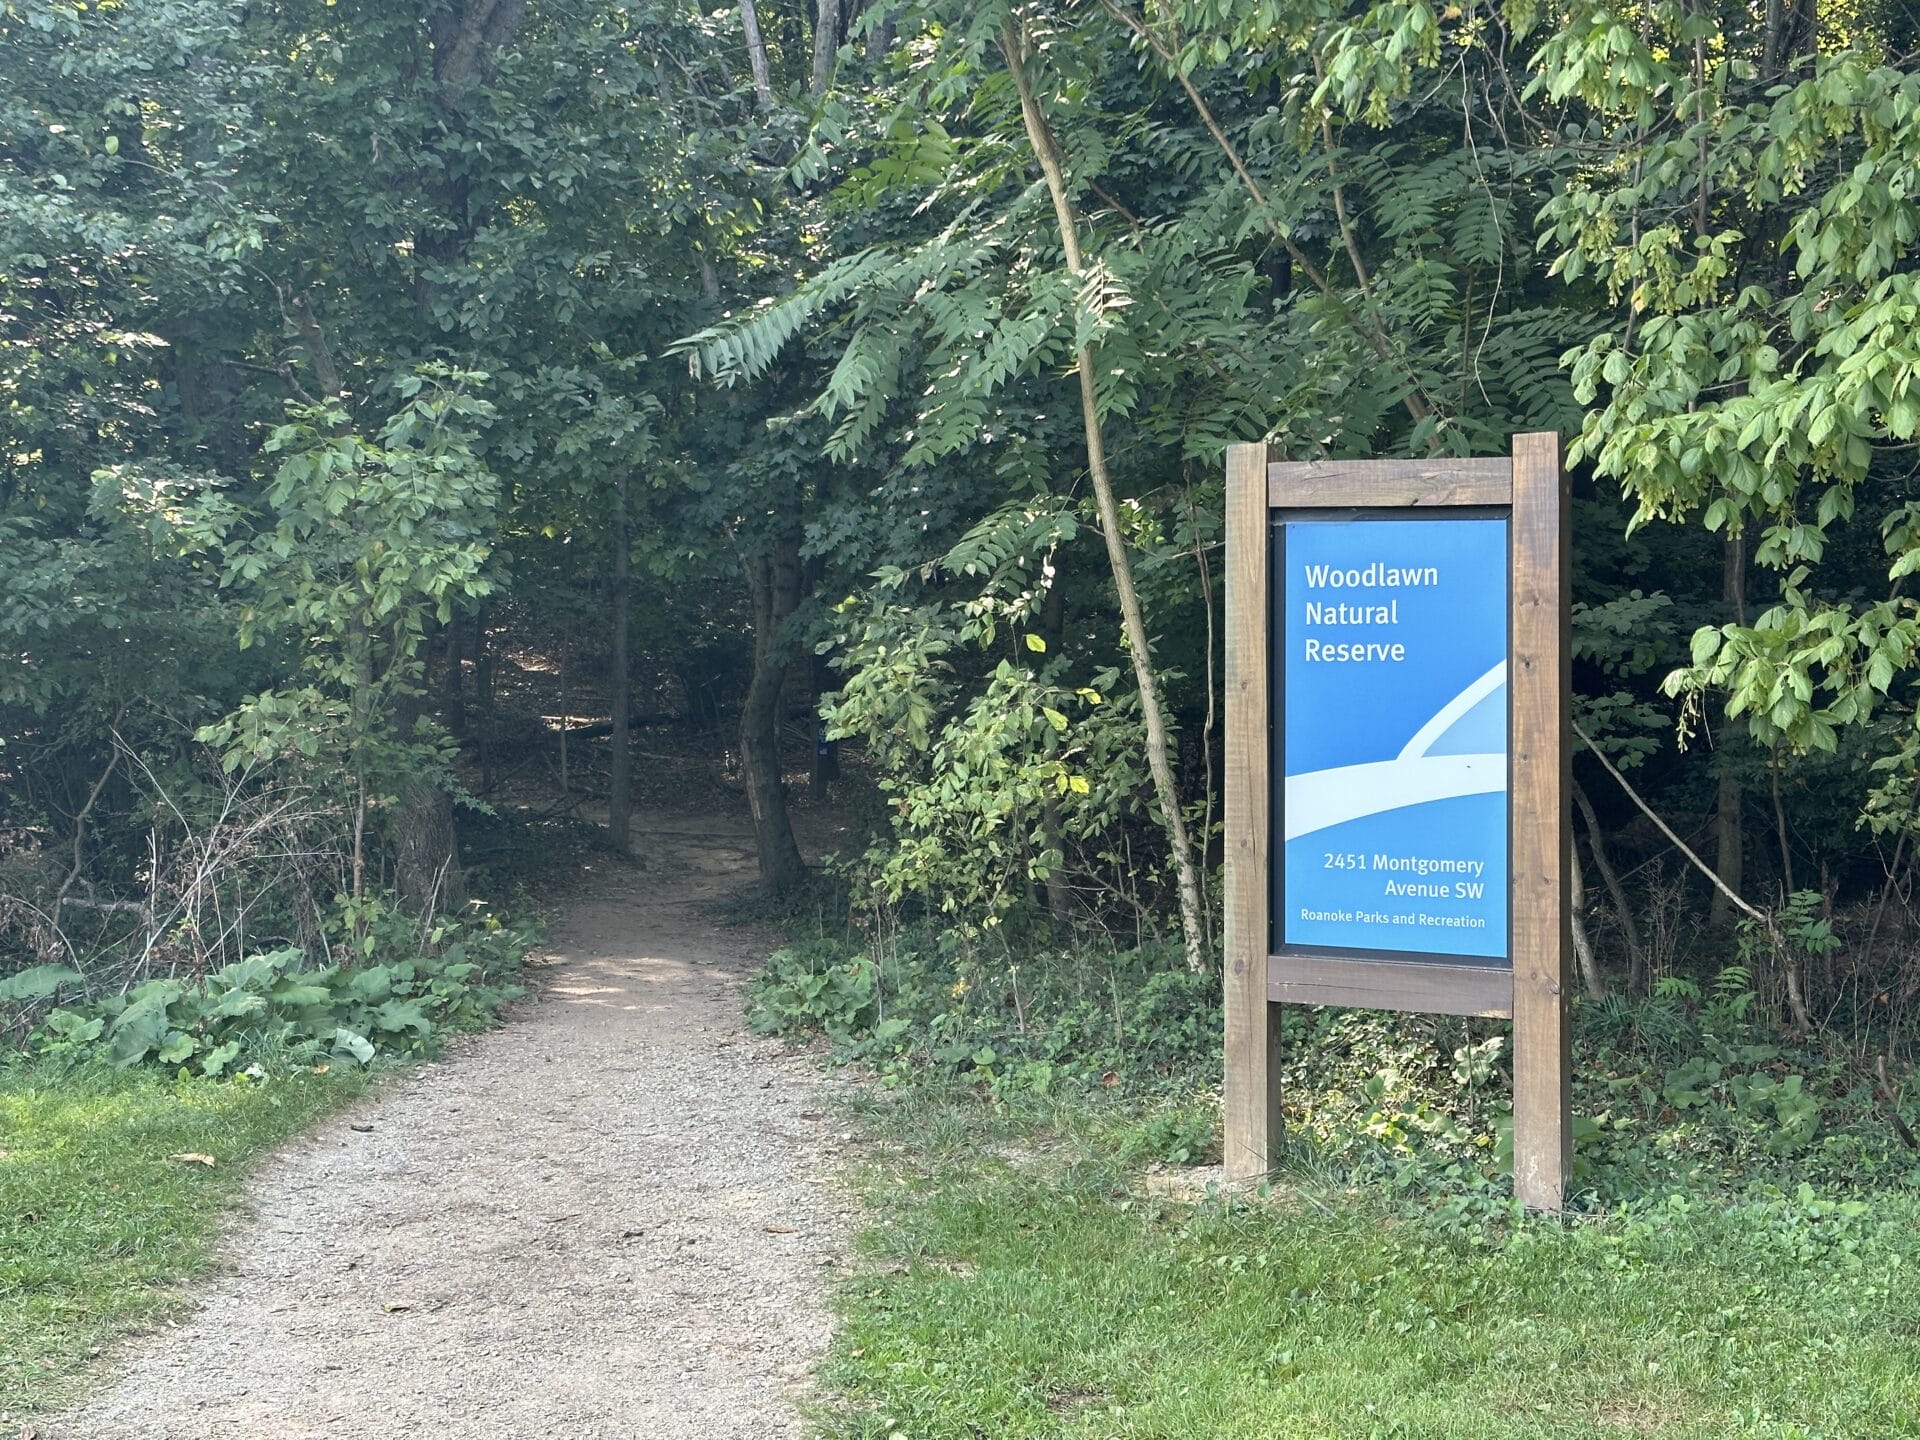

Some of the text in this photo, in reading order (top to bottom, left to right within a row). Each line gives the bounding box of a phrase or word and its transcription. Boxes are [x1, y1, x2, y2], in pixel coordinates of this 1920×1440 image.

[1304, 562, 1438, 588] Woodlawn
[1306, 599, 1398, 625] Natural
[1305, 638, 1405, 662] Reserve
[1323, 853, 1485, 877] 2451 Montgomery
[1384, 879, 1484, 899] Avenue SW
[1301, 908, 1485, 928] Roanoke Parks and Recreation
